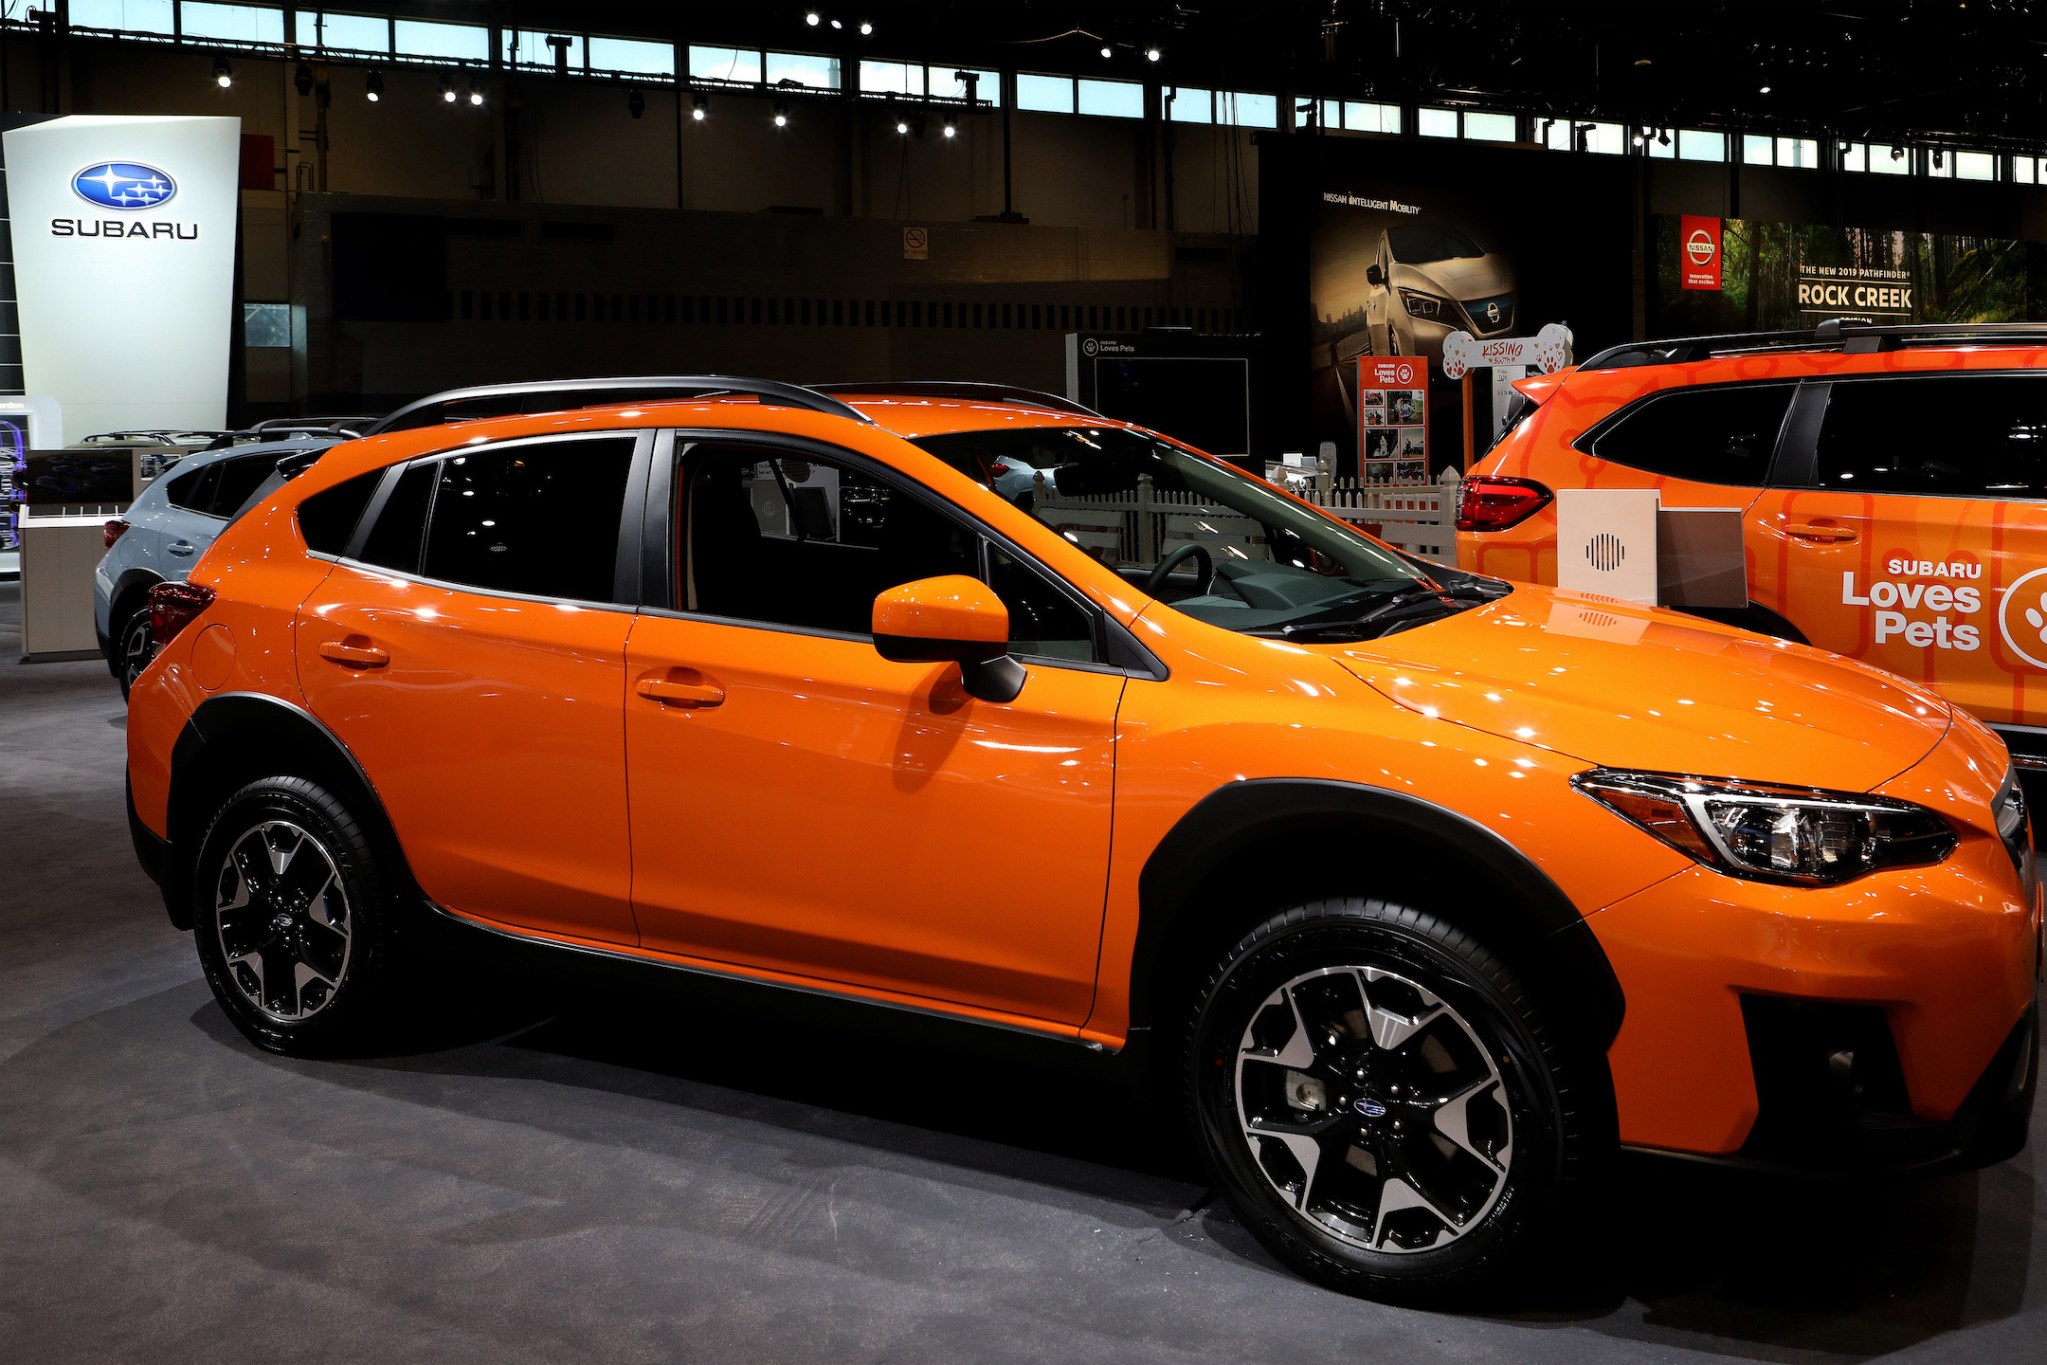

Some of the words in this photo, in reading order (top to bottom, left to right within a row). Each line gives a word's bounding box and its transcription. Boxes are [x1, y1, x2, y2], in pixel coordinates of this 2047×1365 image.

[1323, 192, 1347, 204] NISSAN
[51, 218, 198, 240] SUBARU
[1689, 244, 1713, 252] NISSAN
[1801, 265, 1816, 275] THE
[1818, 266, 1836, 276] NEW
[1838, 267, 1857, 277] 2019
[1798, 284, 1850, 306] ROCK
[1854, 286, 1912, 308] CREEK
[1119, 344, 1135, 352] Pets
[1482, 341, 1523, 360] KISSING
[1374, 368, 1396, 376] Loves
[1379, 375, 1396, 384] Pets
[1888, 559, 1982, 579] SUBARU
[1842, 571, 1982, 613] Loves
[1875, 610, 1981, 651] Pets
